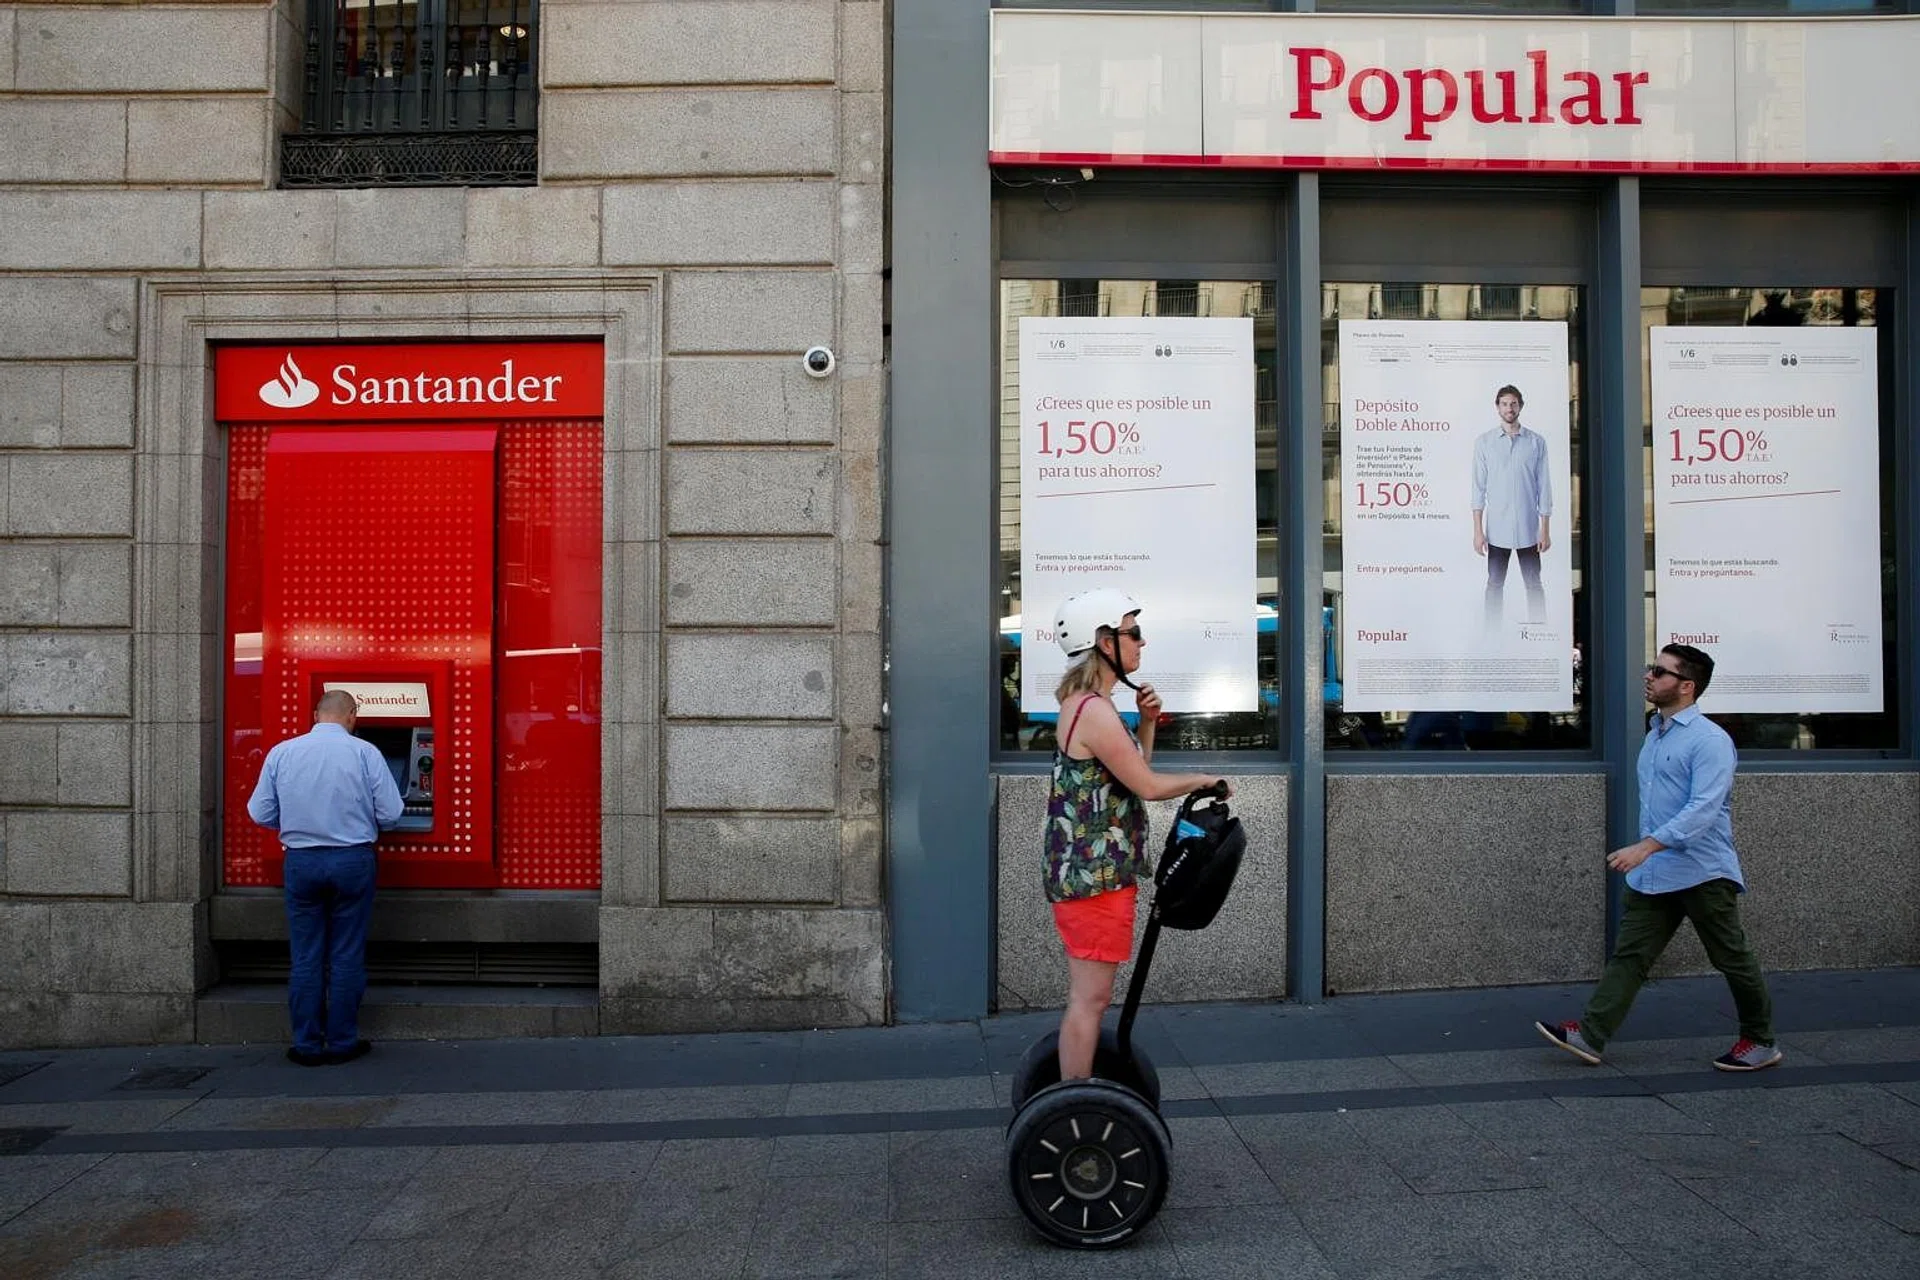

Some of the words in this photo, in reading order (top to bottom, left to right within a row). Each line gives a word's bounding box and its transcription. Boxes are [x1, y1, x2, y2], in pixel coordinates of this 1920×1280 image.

[1288, 47, 1650, 141] Popular
[1050, 340, 1065, 349] 1/6
[1680, 349, 1695, 358] 1/6
[332, 359, 562, 405] Santander
[1036, 396, 1082, 411] ¿Crees
[1086, 398, 1113, 412] que
[1117, 399, 1132, 410] es
[1136, 396, 1189, 412] posible
[1192, 398, 1211, 409] un
[1355, 399, 1419, 415] Depósito
[1668, 405, 1712, 420] ¿Crees
[1715, 407, 1742, 421] que
[1745, 408, 1760, 418] es
[1763, 405, 1814, 420] posible
[1817, 407, 1836, 418] un
[1355, 418, 1397, 431] Doble
[1400, 418, 1450, 431] Ahorro
[1039, 466, 1070, 480] para
[1074, 466, 1096, 477] tus
[1100, 464, 1162, 478] ahorros?
[1671, 474, 1701, 487] para
[1705, 473, 1726, 485] tus
[1729, 472, 1789, 485] ahorros?
[1378, 512, 1410, 520] Depósito
[1035, 564, 1059, 572] Entra
[1061, 565, 1066, 574] y
[1068, 563, 1126, 574] pregúntanos.
[1357, 564, 1379, 573] Entra
[1382, 566, 1387, 575] y
[1389, 564, 1444, 575] pregúntanos.
[1700, 568, 1755, 578] pregúntanos.
[1357, 630, 1408, 644] Popular
[1671, 632, 1720, 645] Popular
[356, 693, 418, 705] Santander
